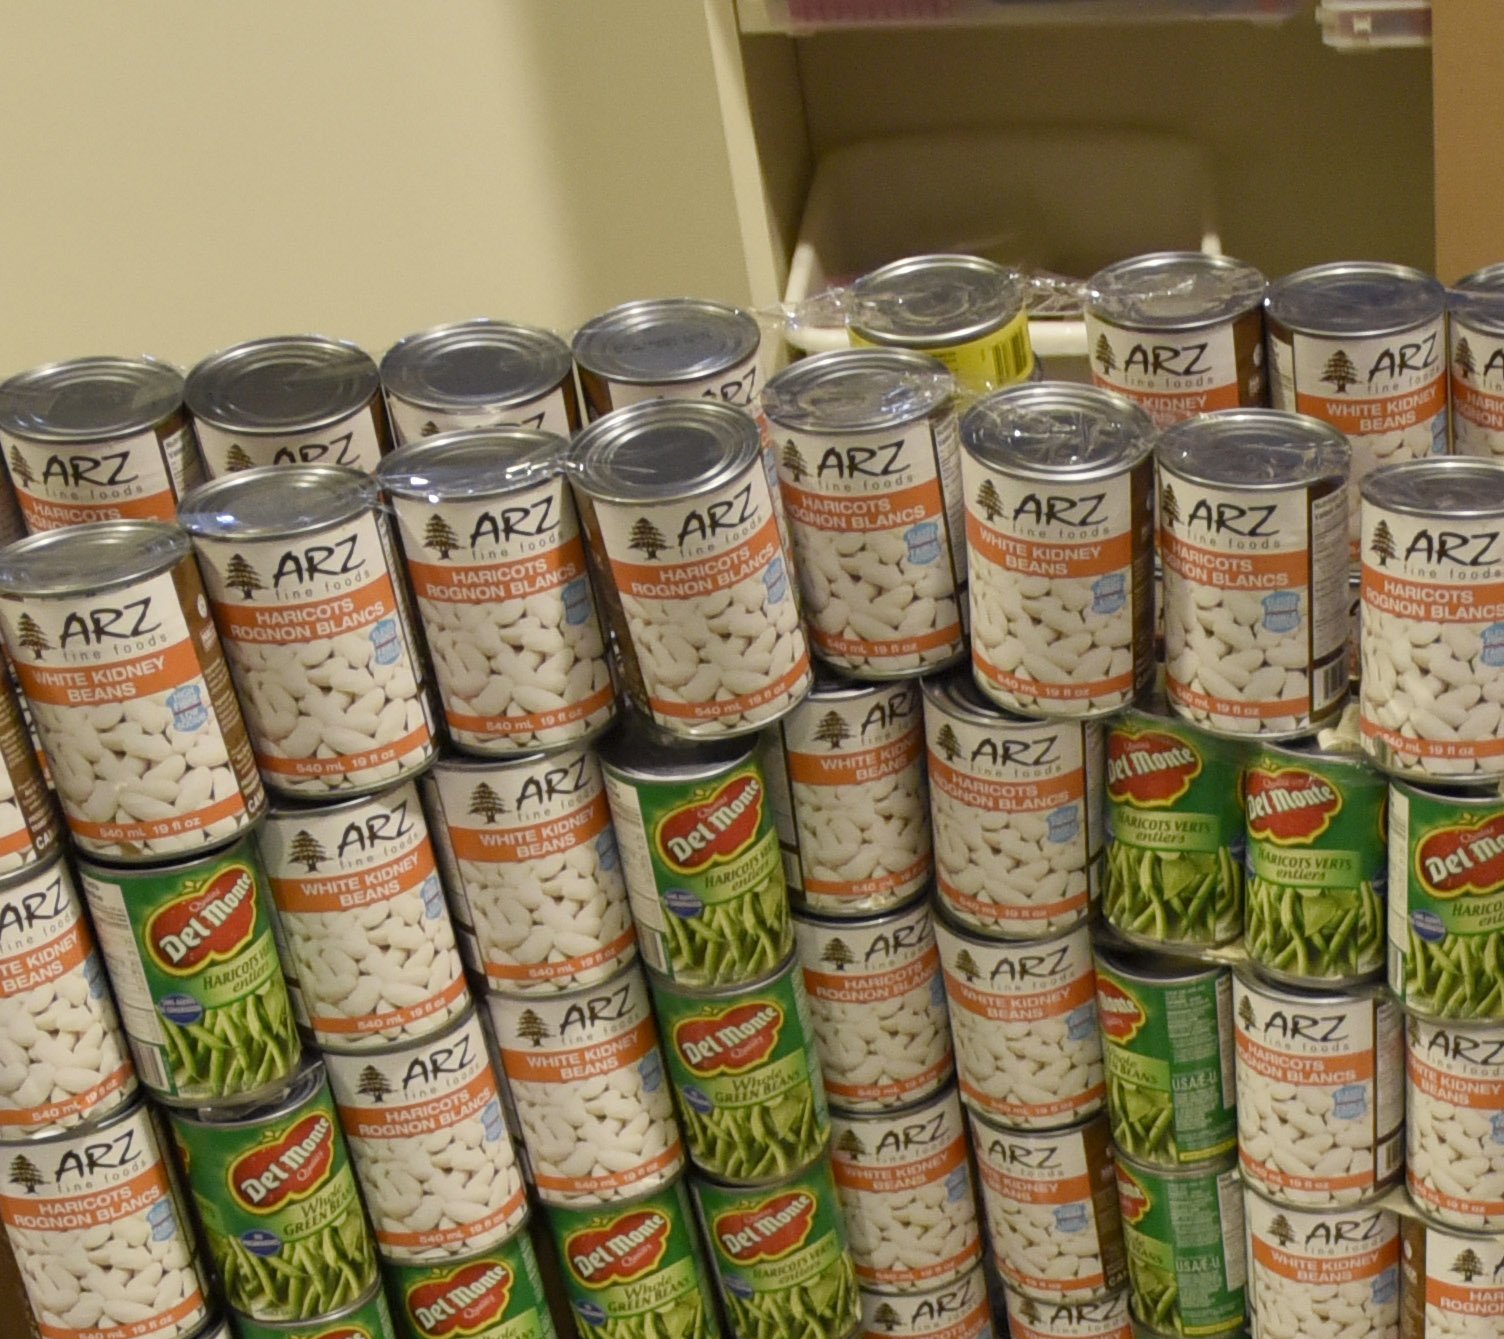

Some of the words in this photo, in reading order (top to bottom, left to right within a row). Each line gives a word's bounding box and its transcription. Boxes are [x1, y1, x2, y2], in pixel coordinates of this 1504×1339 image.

[1124, 342, 1212, 375] ARZ
[1368, 332, 1438, 382] ARZ
[1326, 402, 1381, 417] WHITE
[1387, 388, 1437, 413] KIDNEY
[1360, 413, 1416, 431] BEANS
[43, 451, 138, 485] ARZ
[817, 439, 911, 478] ARZ
[678, 482, 758, 546] ARZ
[801, 496, 890, 513] HARICOTS
[851, 506, 925, 528] BLANCS
[1013, 492, 1108, 526] ARZ
[1187, 500, 1280, 537] ARZ
[470, 496, 559, 548] ARZ
[273, 534, 365, 589] ARZ
[980, 529, 1026, 557] WHITE
[1031, 546, 1101, 561] KIDNEY
[1405, 529, 1501, 566] ARZ
[427, 581, 505, 598] ROGNON
[512, 563, 576, 594] BLANCS
[452, 558, 547, 585] HARICOTS
[660, 546, 751, 582] HARICOTS
[1005, 555, 1067, 575] BEANS
[1213, 572, 1288, 586] BLANCS
[1384, 579, 1473, 603] HARICOTS
[60, 597, 161, 649] ARZ
[231, 622, 312, 642] ROGNON
[317, 603, 384, 635] BLANCS
[257, 597, 354, 625] HARICOTS
[32, 669, 90, 687] WHITE
[96, 657, 165, 681] KIDNEY
[67, 684, 135, 702] BEANS
[971, 735, 1062, 767] ARZ
[516, 755, 592, 811] ARZ
[337, 802, 415, 858] ARZ
[479, 830, 537, 846] WHITE
[541, 808, 594, 837] KIDNEY
[516, 834, 576, 857] BEANS
[301, 879, 359, 895] WHITE
[363, 852, 418, 888] KIDNEY
[1424, 852, 1473, 885] Del
[341, 880, 400, 906] BEANS
[158, 914, 211, 964] Del
[205, 870, 252, 927] Monte
[26, 933, 78, 967] KIDNEY
[990, 945, 1073, 985] ARZ
[1, 962, 64, 992] BEANS
[559, 984, 636, 1035] ARZ
[1010, 988, 1071, 1009] KIDNEY
[683, 1033, 726, 1065] Del
[724, 1008, 778, 1048] Monte
[1264, 1011, 1348, 1041] ARZ
[403, 1034, 476, 1089] ARZ
[526, 1052, 581, 1069] WHITE
[585, 1031, 639, 1061] KIDNEY
[561, 1058, 619, 1080] BEANS
[385, 1091, 470, 1123] HARICOTS
[55, 1129, 142, 1183] ARZ
[241, 1162, 287, 1203] Del
[284, 1116, 330, 1168] Monte
[14, 1211, 91, 1227] ROGNON
[96, 1186, 161, 1224] BLANCS
[39, 1186, 132, 1214] HARICOTS
[574, 1245, 616, 1277] Del
[615, 1214, 665, 1255] Monte
[1305, 1215, 1384, 1246] ARZ
[415, 1304, 457, 1330] Del
[454, 1267, 508, 1310] Monte
